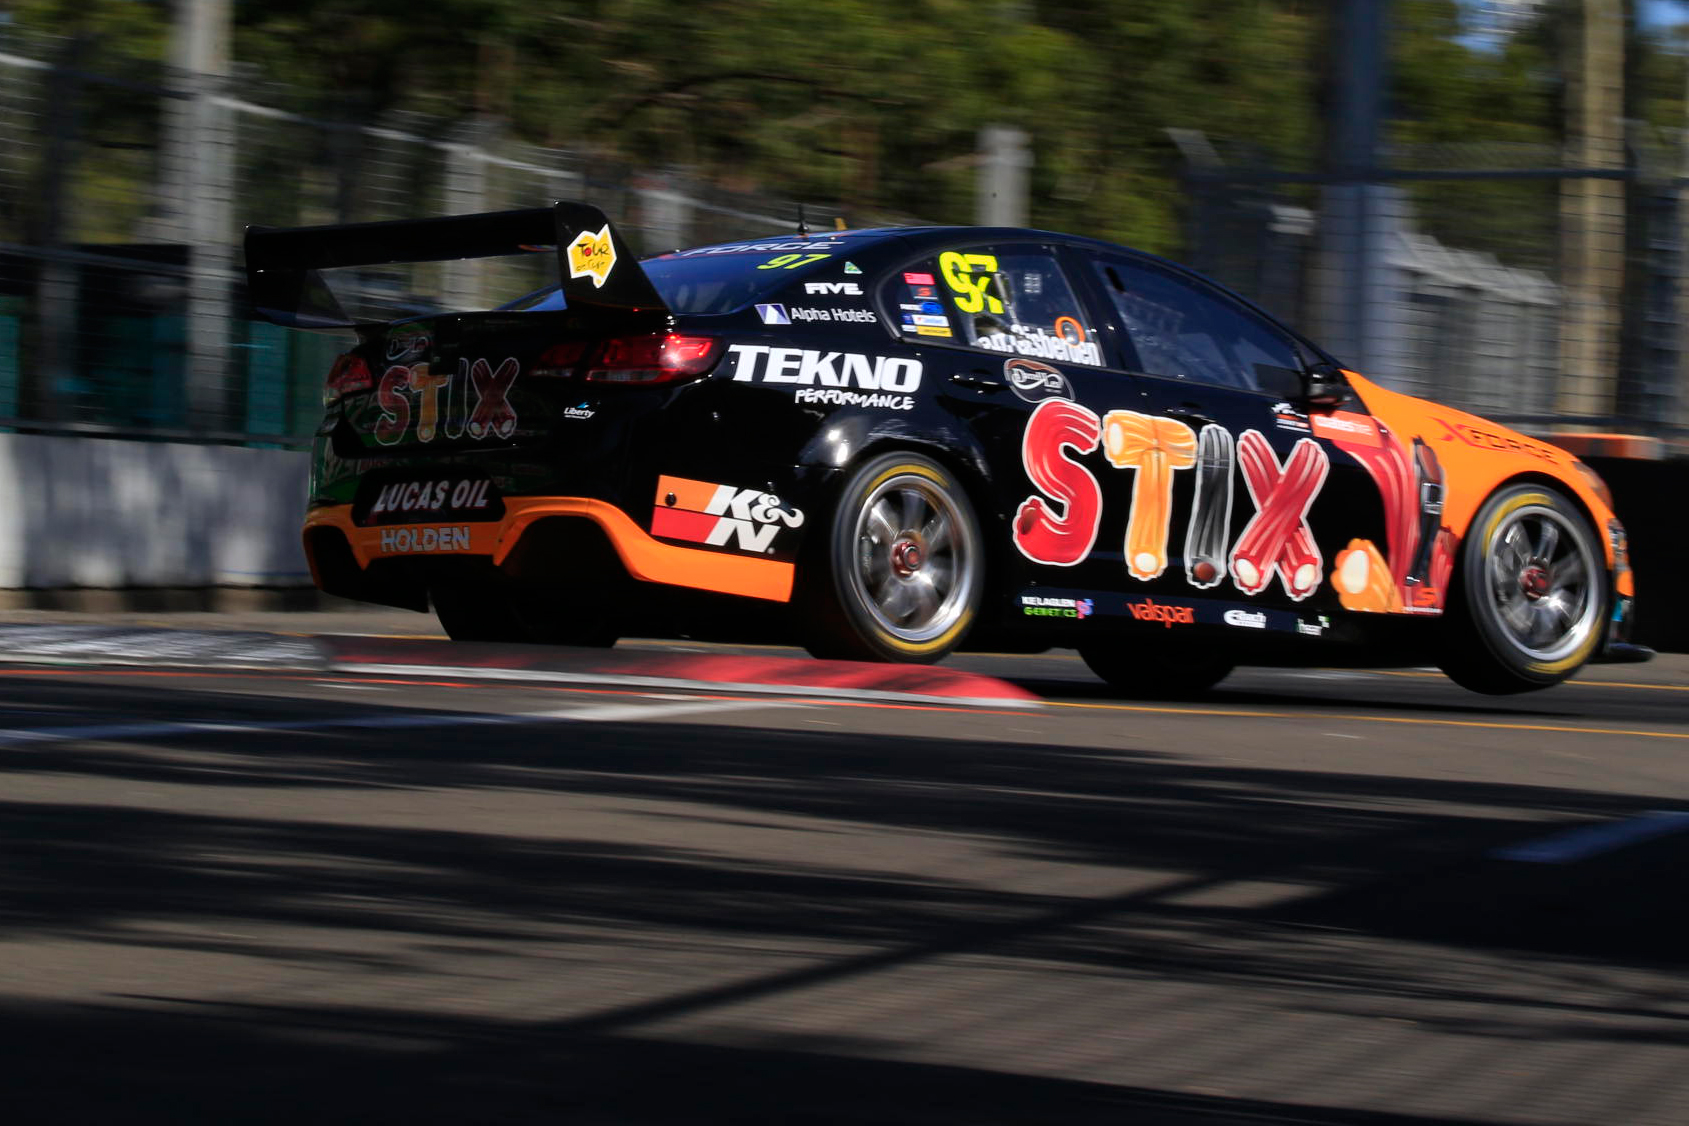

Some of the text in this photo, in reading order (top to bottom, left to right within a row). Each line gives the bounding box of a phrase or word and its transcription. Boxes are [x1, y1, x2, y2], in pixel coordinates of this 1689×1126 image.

[756, 253, 832, 270] 97
[939, 251, 1004, 314] 97
[791, 307, 877, 324] Alpha Hotels
[728, 344, 923, 393] TEKNO
[374, 356, 521, 446] STIX
[795, 388, 916, 411] PERFORMANCE
[373, 479, 492, 514] LUCAS OIL
[1013, 397, 1330, 601] STIX
[380, 526, 470, 553] HOLDEN
[1126, 598, 1195, 629] valspar
